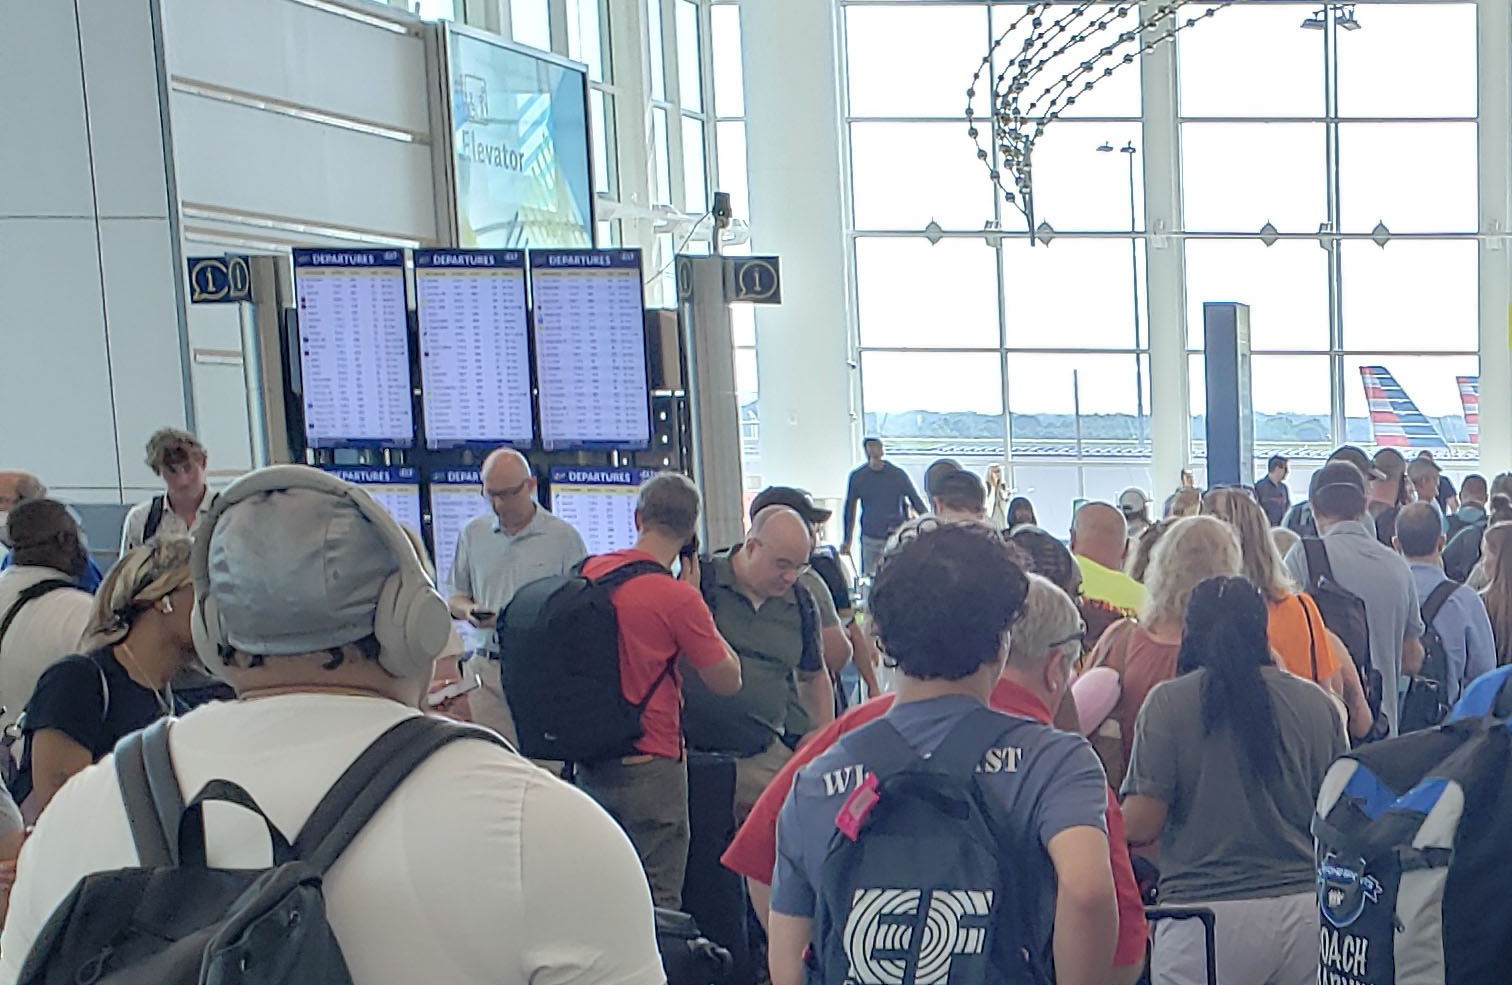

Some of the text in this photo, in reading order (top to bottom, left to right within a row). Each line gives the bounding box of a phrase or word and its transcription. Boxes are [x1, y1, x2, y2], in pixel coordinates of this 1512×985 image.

[462, 129, 525, 172] Elevator
[312, 253, 375, 265] DEPARTURES
[433, 254, 495, 265] DEPARTURES
[549, 255, 611, 266] DEPARTURES
[448, 471, 482, 482] DEPAR
[569, 470, 630, 483] DEPARTURES
[1320, 925, 1369, 977] OACH
